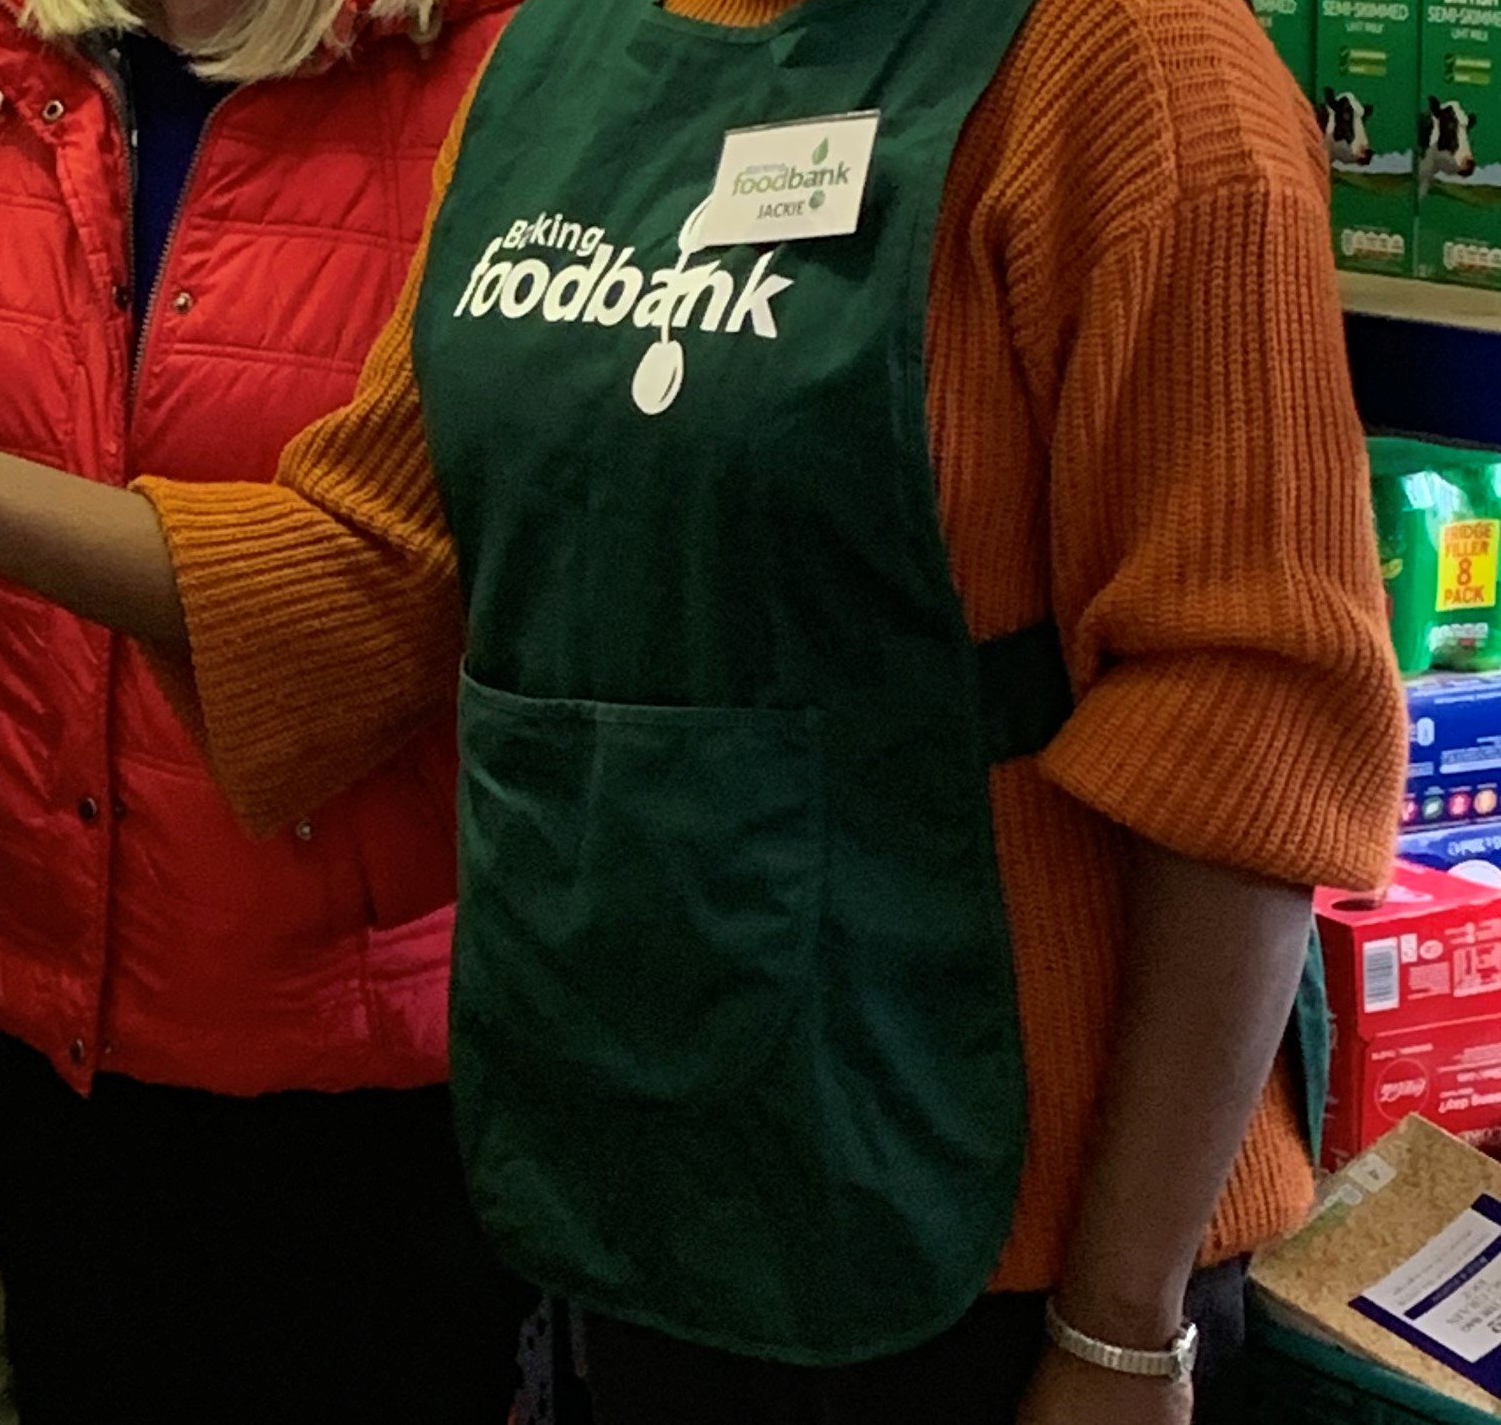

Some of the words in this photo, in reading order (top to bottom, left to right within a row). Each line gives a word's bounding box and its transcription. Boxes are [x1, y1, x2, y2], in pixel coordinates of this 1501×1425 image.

[1322, 0, 1409, 21] SEMI-SKIMMED
[731, 160, 851, 197] foodbank
[757, 200, 805, 220] JACKIE
[453, 236, 794, 339] foodbank
[1457, 558, 1472, 586] 8
[1444, 585, 1485, 606] PACK
